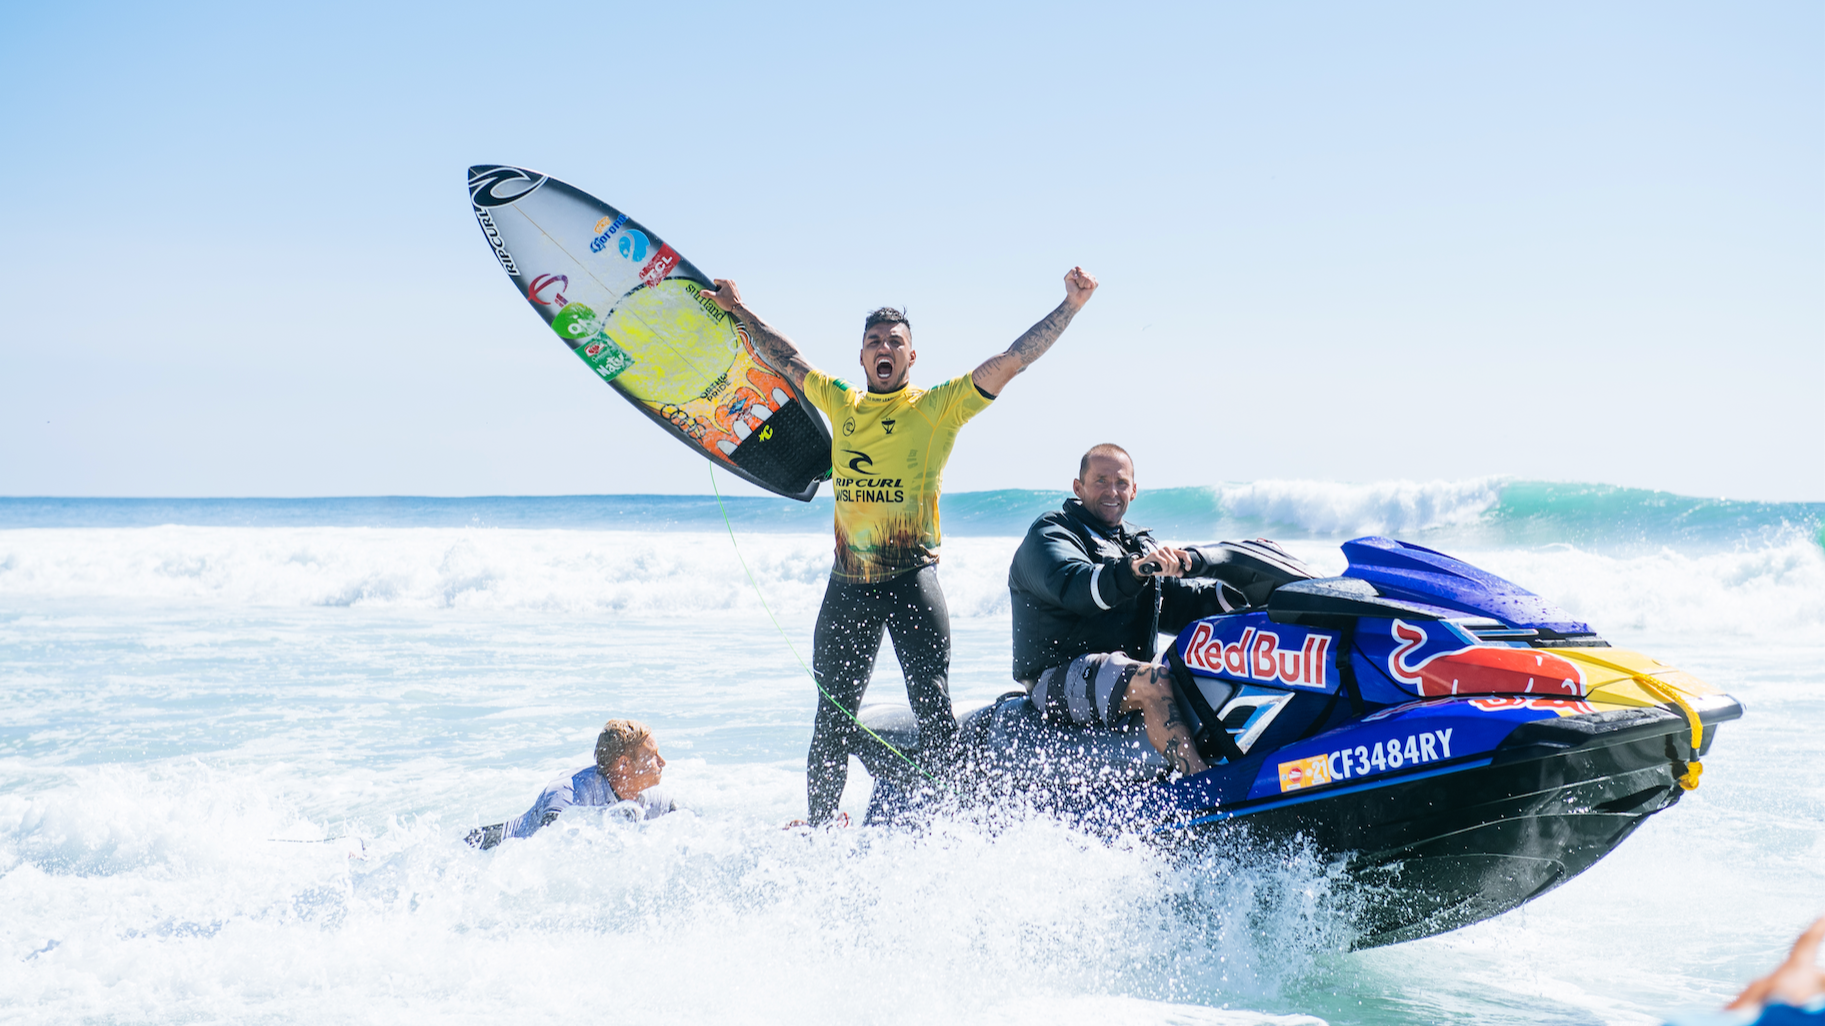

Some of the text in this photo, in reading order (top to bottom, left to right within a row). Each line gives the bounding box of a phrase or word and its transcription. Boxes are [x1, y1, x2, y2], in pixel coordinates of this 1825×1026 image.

[478, 207, 518, 274] RIP CURL
[589, 213, 627, 253] Corona
[645, 256, 673, 280] TCL
[707, 379, 731, 402] PRIDE
[836, 477, 904, 488] RIP CURL
[836, 489, 904, 503] WSL FINALS
[1185, 622, 1331, 688] Red Bull
[1328, 728, 1453, 780] CF3484RY
[1311, 760, 1328, 780] 21
